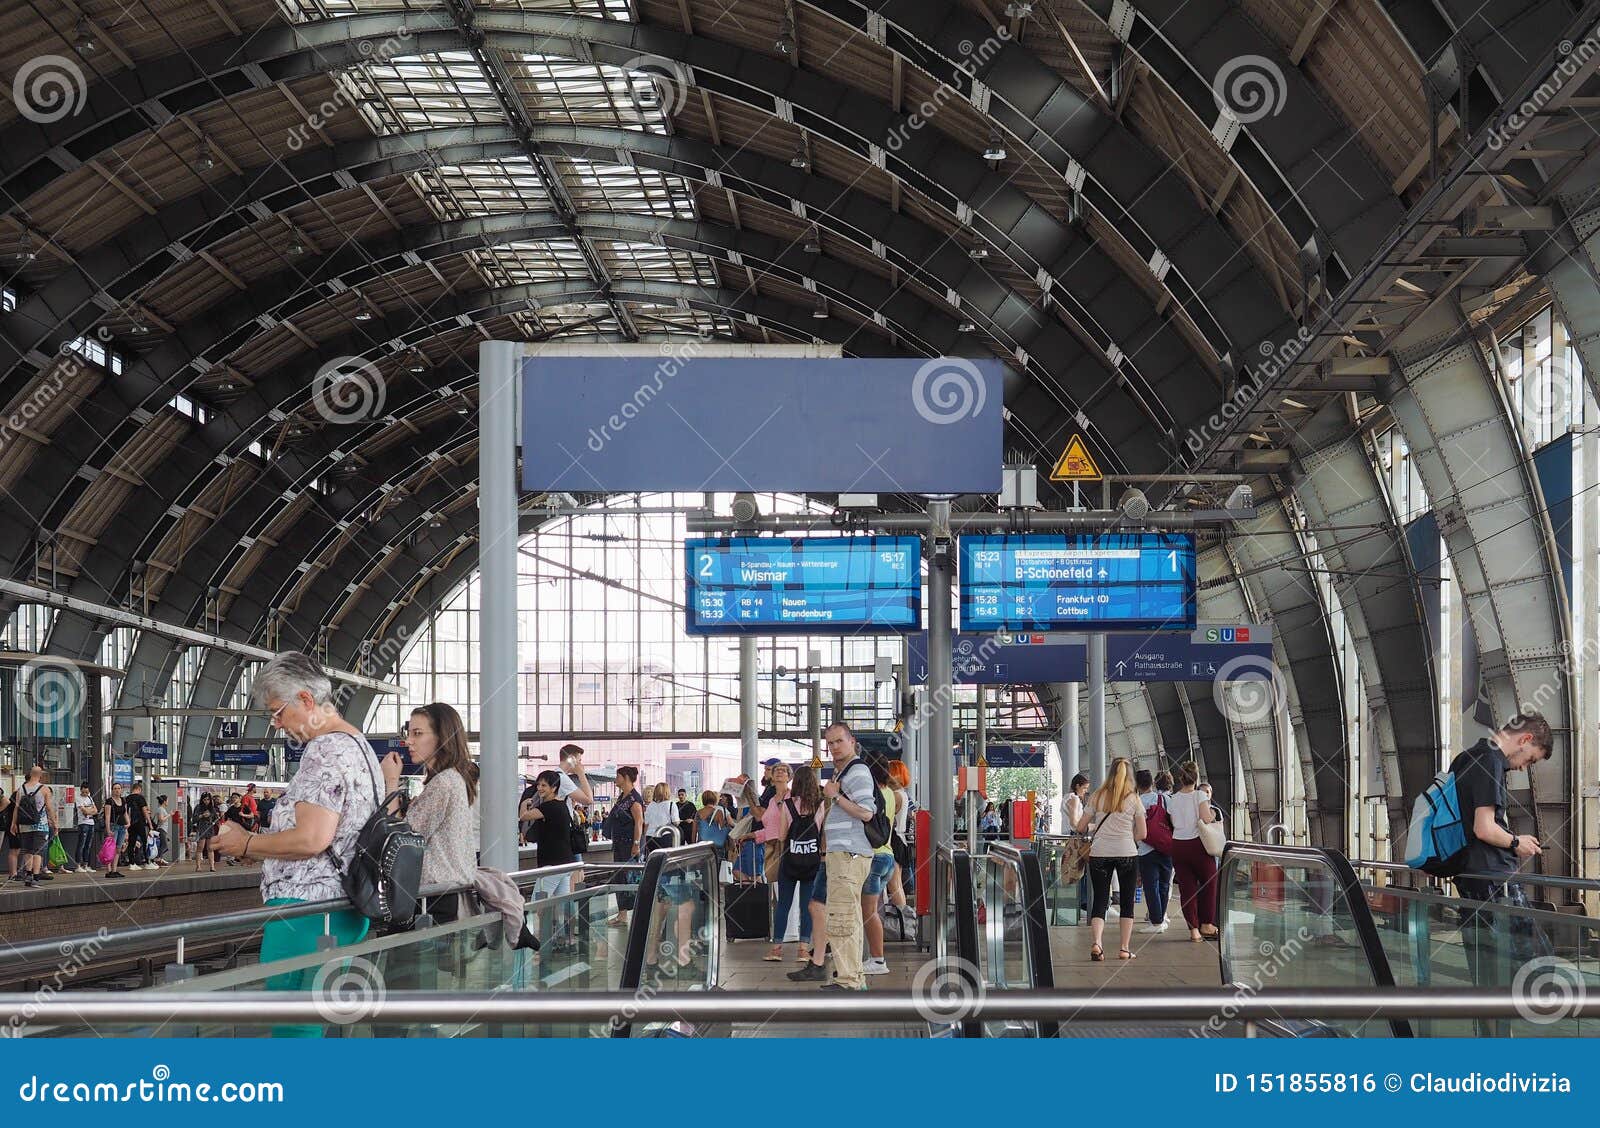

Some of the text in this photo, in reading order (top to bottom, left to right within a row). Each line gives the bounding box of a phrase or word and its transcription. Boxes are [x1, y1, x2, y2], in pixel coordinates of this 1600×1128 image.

[881, 552, 904, 562] 15:17
[975, 551, 999, 561] 15:23
[1168, 550, 1177, 572] 1
[700, 554, 713, 576] 2
[741, 570, 787, 581] Wismar
[701, 599, 723, 607] 15:30
[975, 596, 998, 604] 15:28
[1056, 595, 1095, 603] Frankfurt
[701, 610, 724, 619] 15:33
[782, 609, 833, 619] Brandenburg
[975, 607, 998, 616] 15:43
[1056, 607, 1089, 615] Cottbus
[1018, 634, 1027, 643] U
[1207, 629, 1218, 641] S
[1223, 629, 1233, 641] U
[1135, 653, 1164, 661] Ausgang
[1134, 662, 1183, 670] Rathausstraße
[224, 722, 233, 735] 4
[789, 838, 818, 854] VANS
